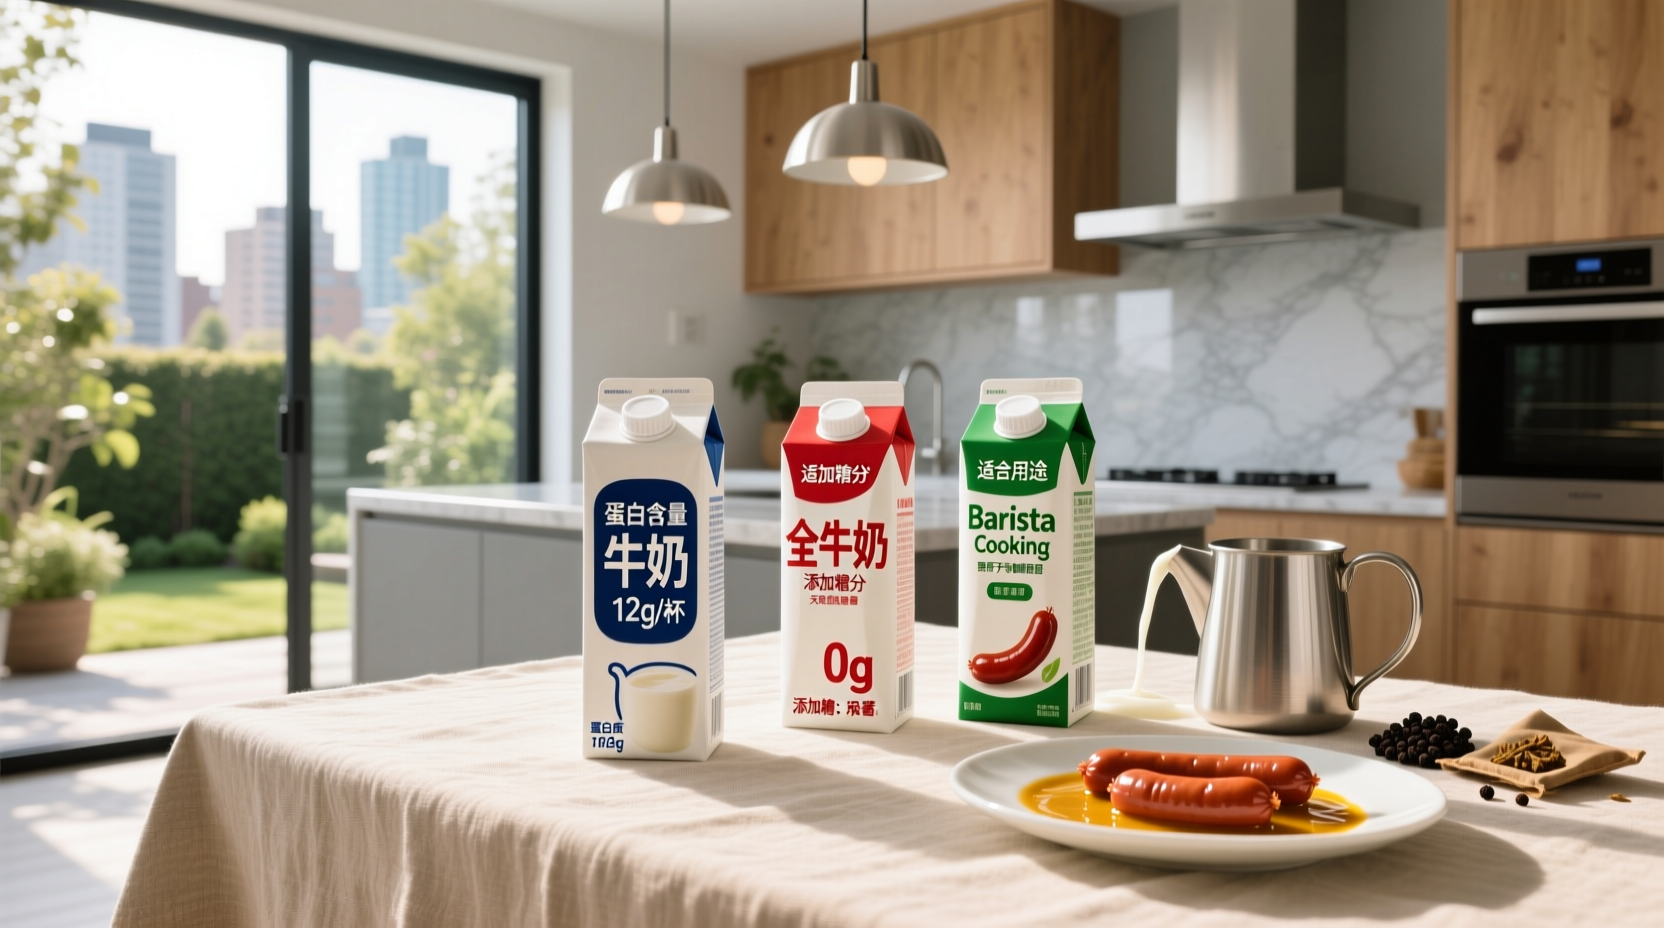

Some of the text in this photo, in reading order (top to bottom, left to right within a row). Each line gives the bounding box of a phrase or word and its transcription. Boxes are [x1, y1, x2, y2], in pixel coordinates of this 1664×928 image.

[977, 459, 1048, 482] 适合用途
[604, 501, 688, 527] 蛋白含量
[968, 504, 1056, 533] Barista
[786, 517, 888, 570] 全牛奶
[974, 534, 1050, 561] Cooking
[604, 532, 689, 589] 牛奶
[612, 596, 686, 630] 12g/杯
[823, 641, 873, 694] 0g
